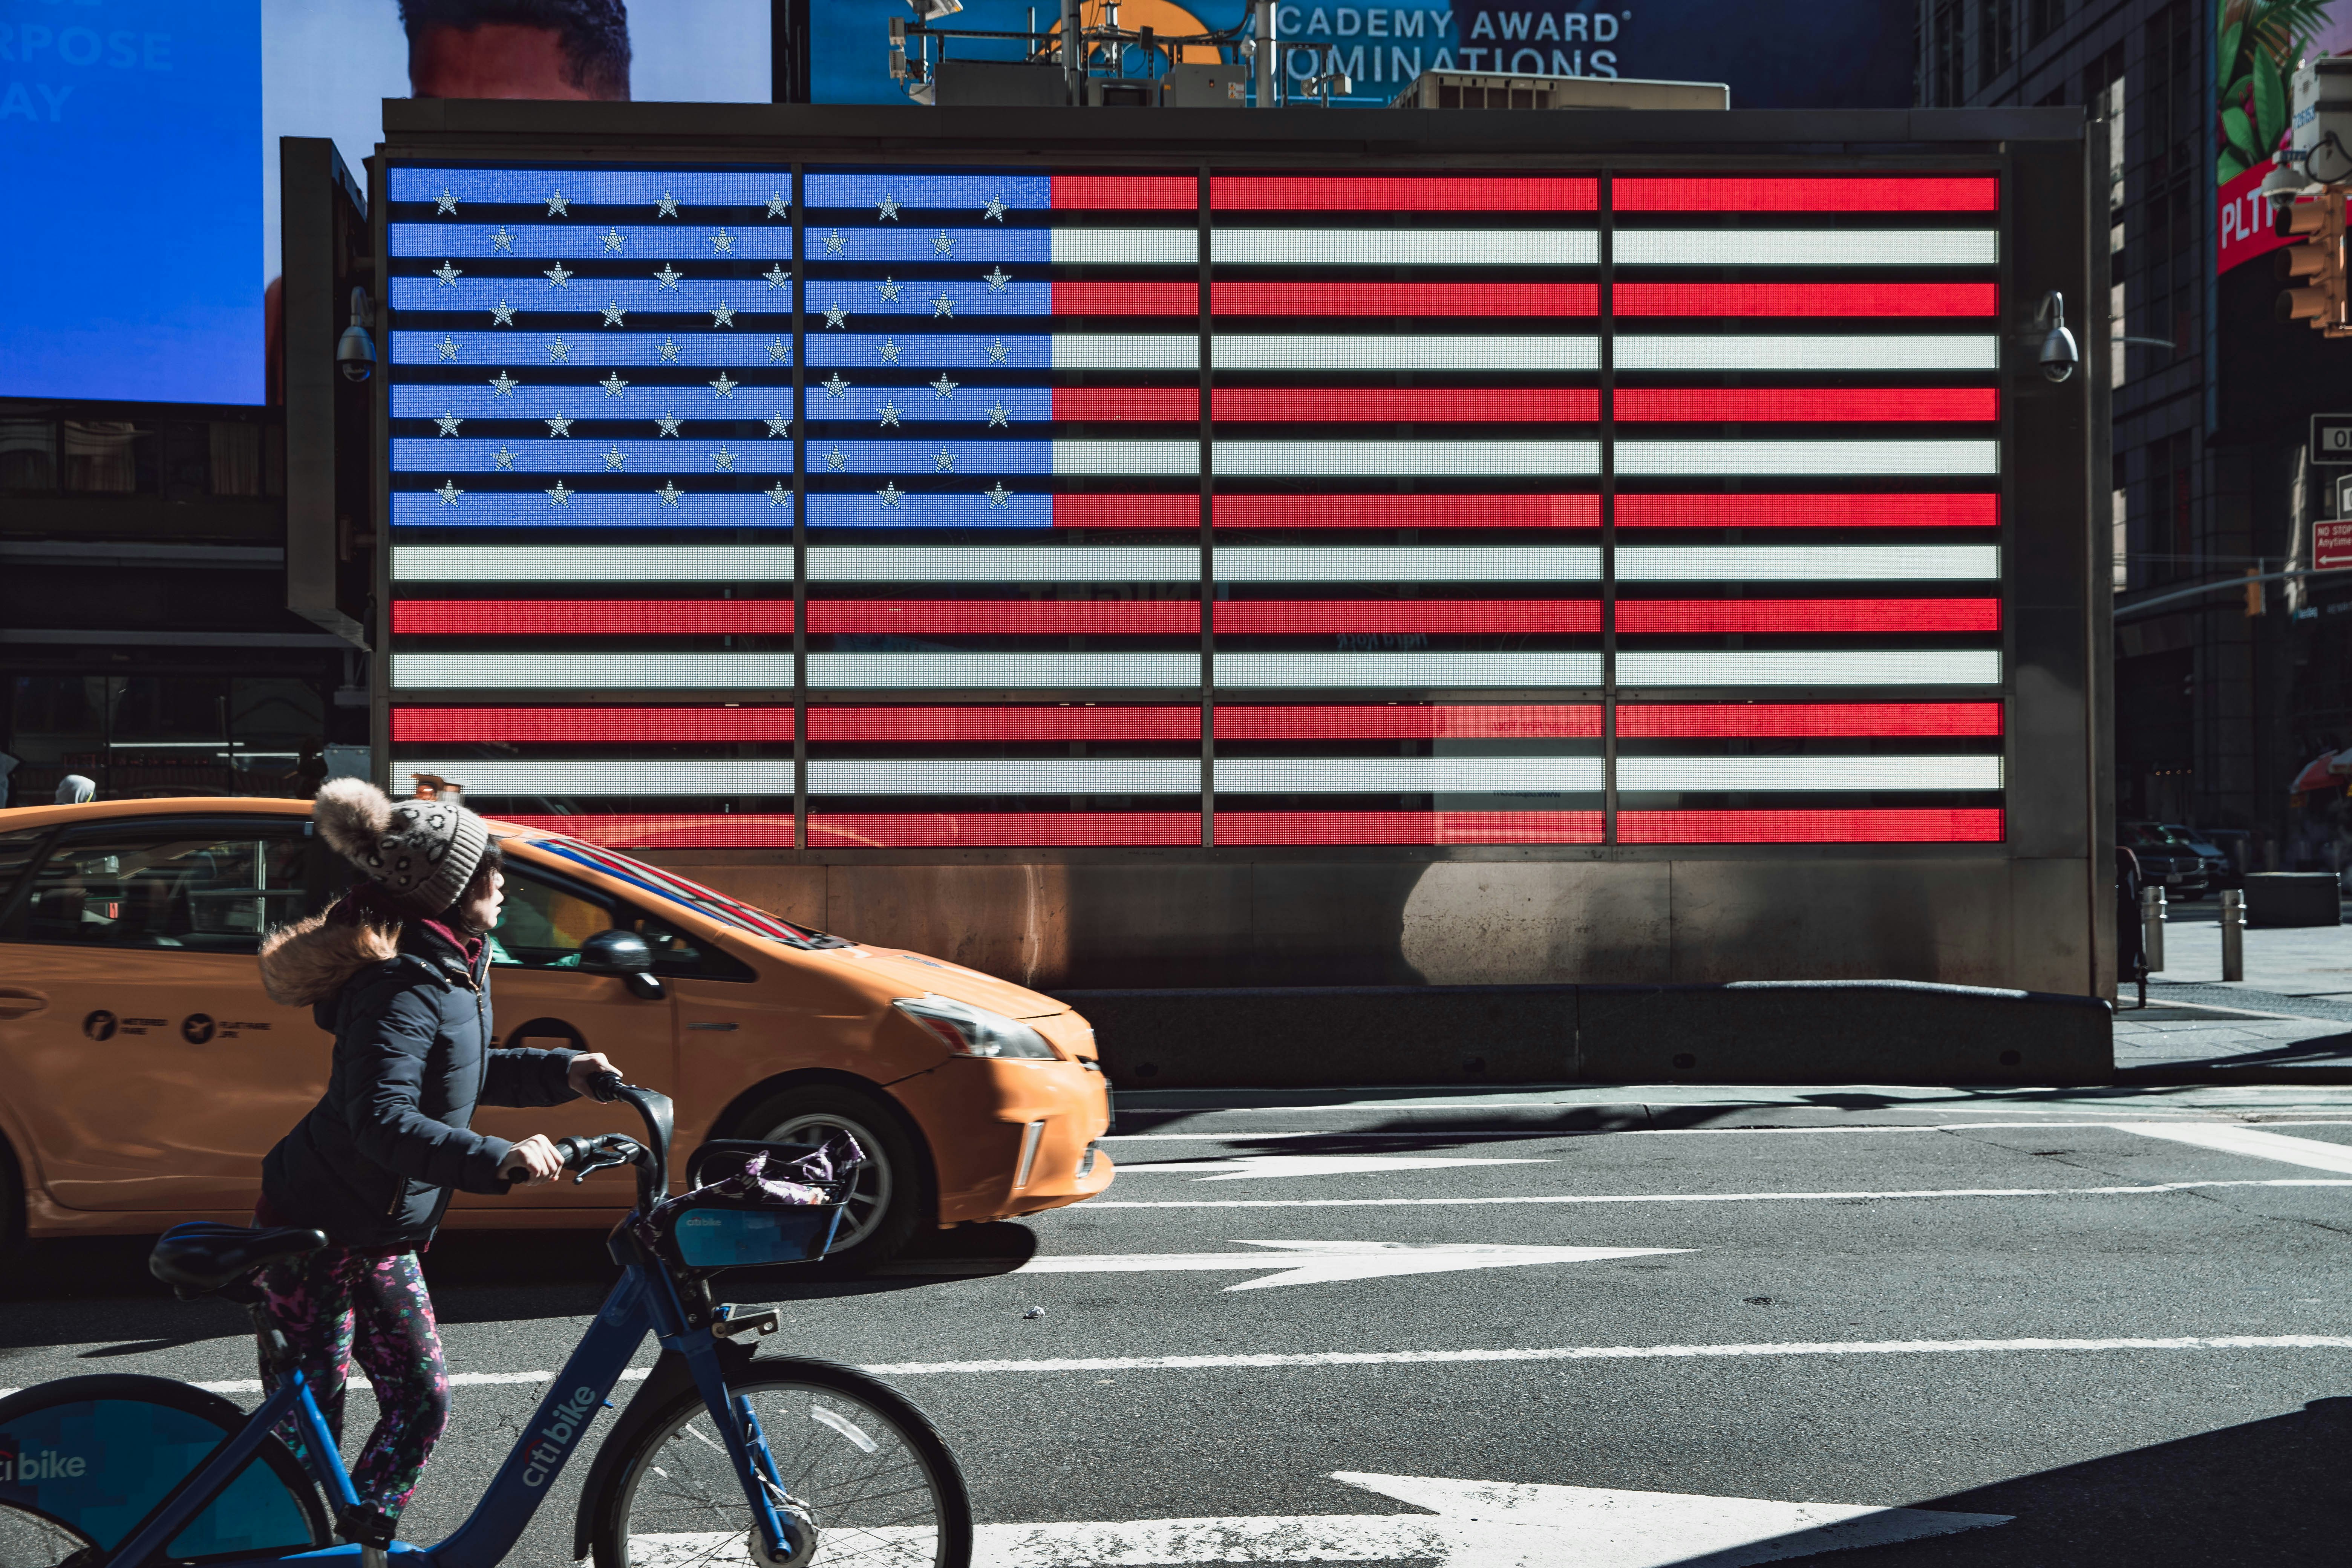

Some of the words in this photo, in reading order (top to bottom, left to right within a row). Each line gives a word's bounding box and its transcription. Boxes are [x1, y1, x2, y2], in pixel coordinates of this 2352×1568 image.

[1250, 46, 1618, 83] OMINATIONS
[2317, 526, 2330, 537] NO
[2317, 536, 2352, 549] Anytime
[541, 1386, 596, 1444] bike
[18, 1450, 86, 1480] bike
[522, 1442, 561, 1487] citi
